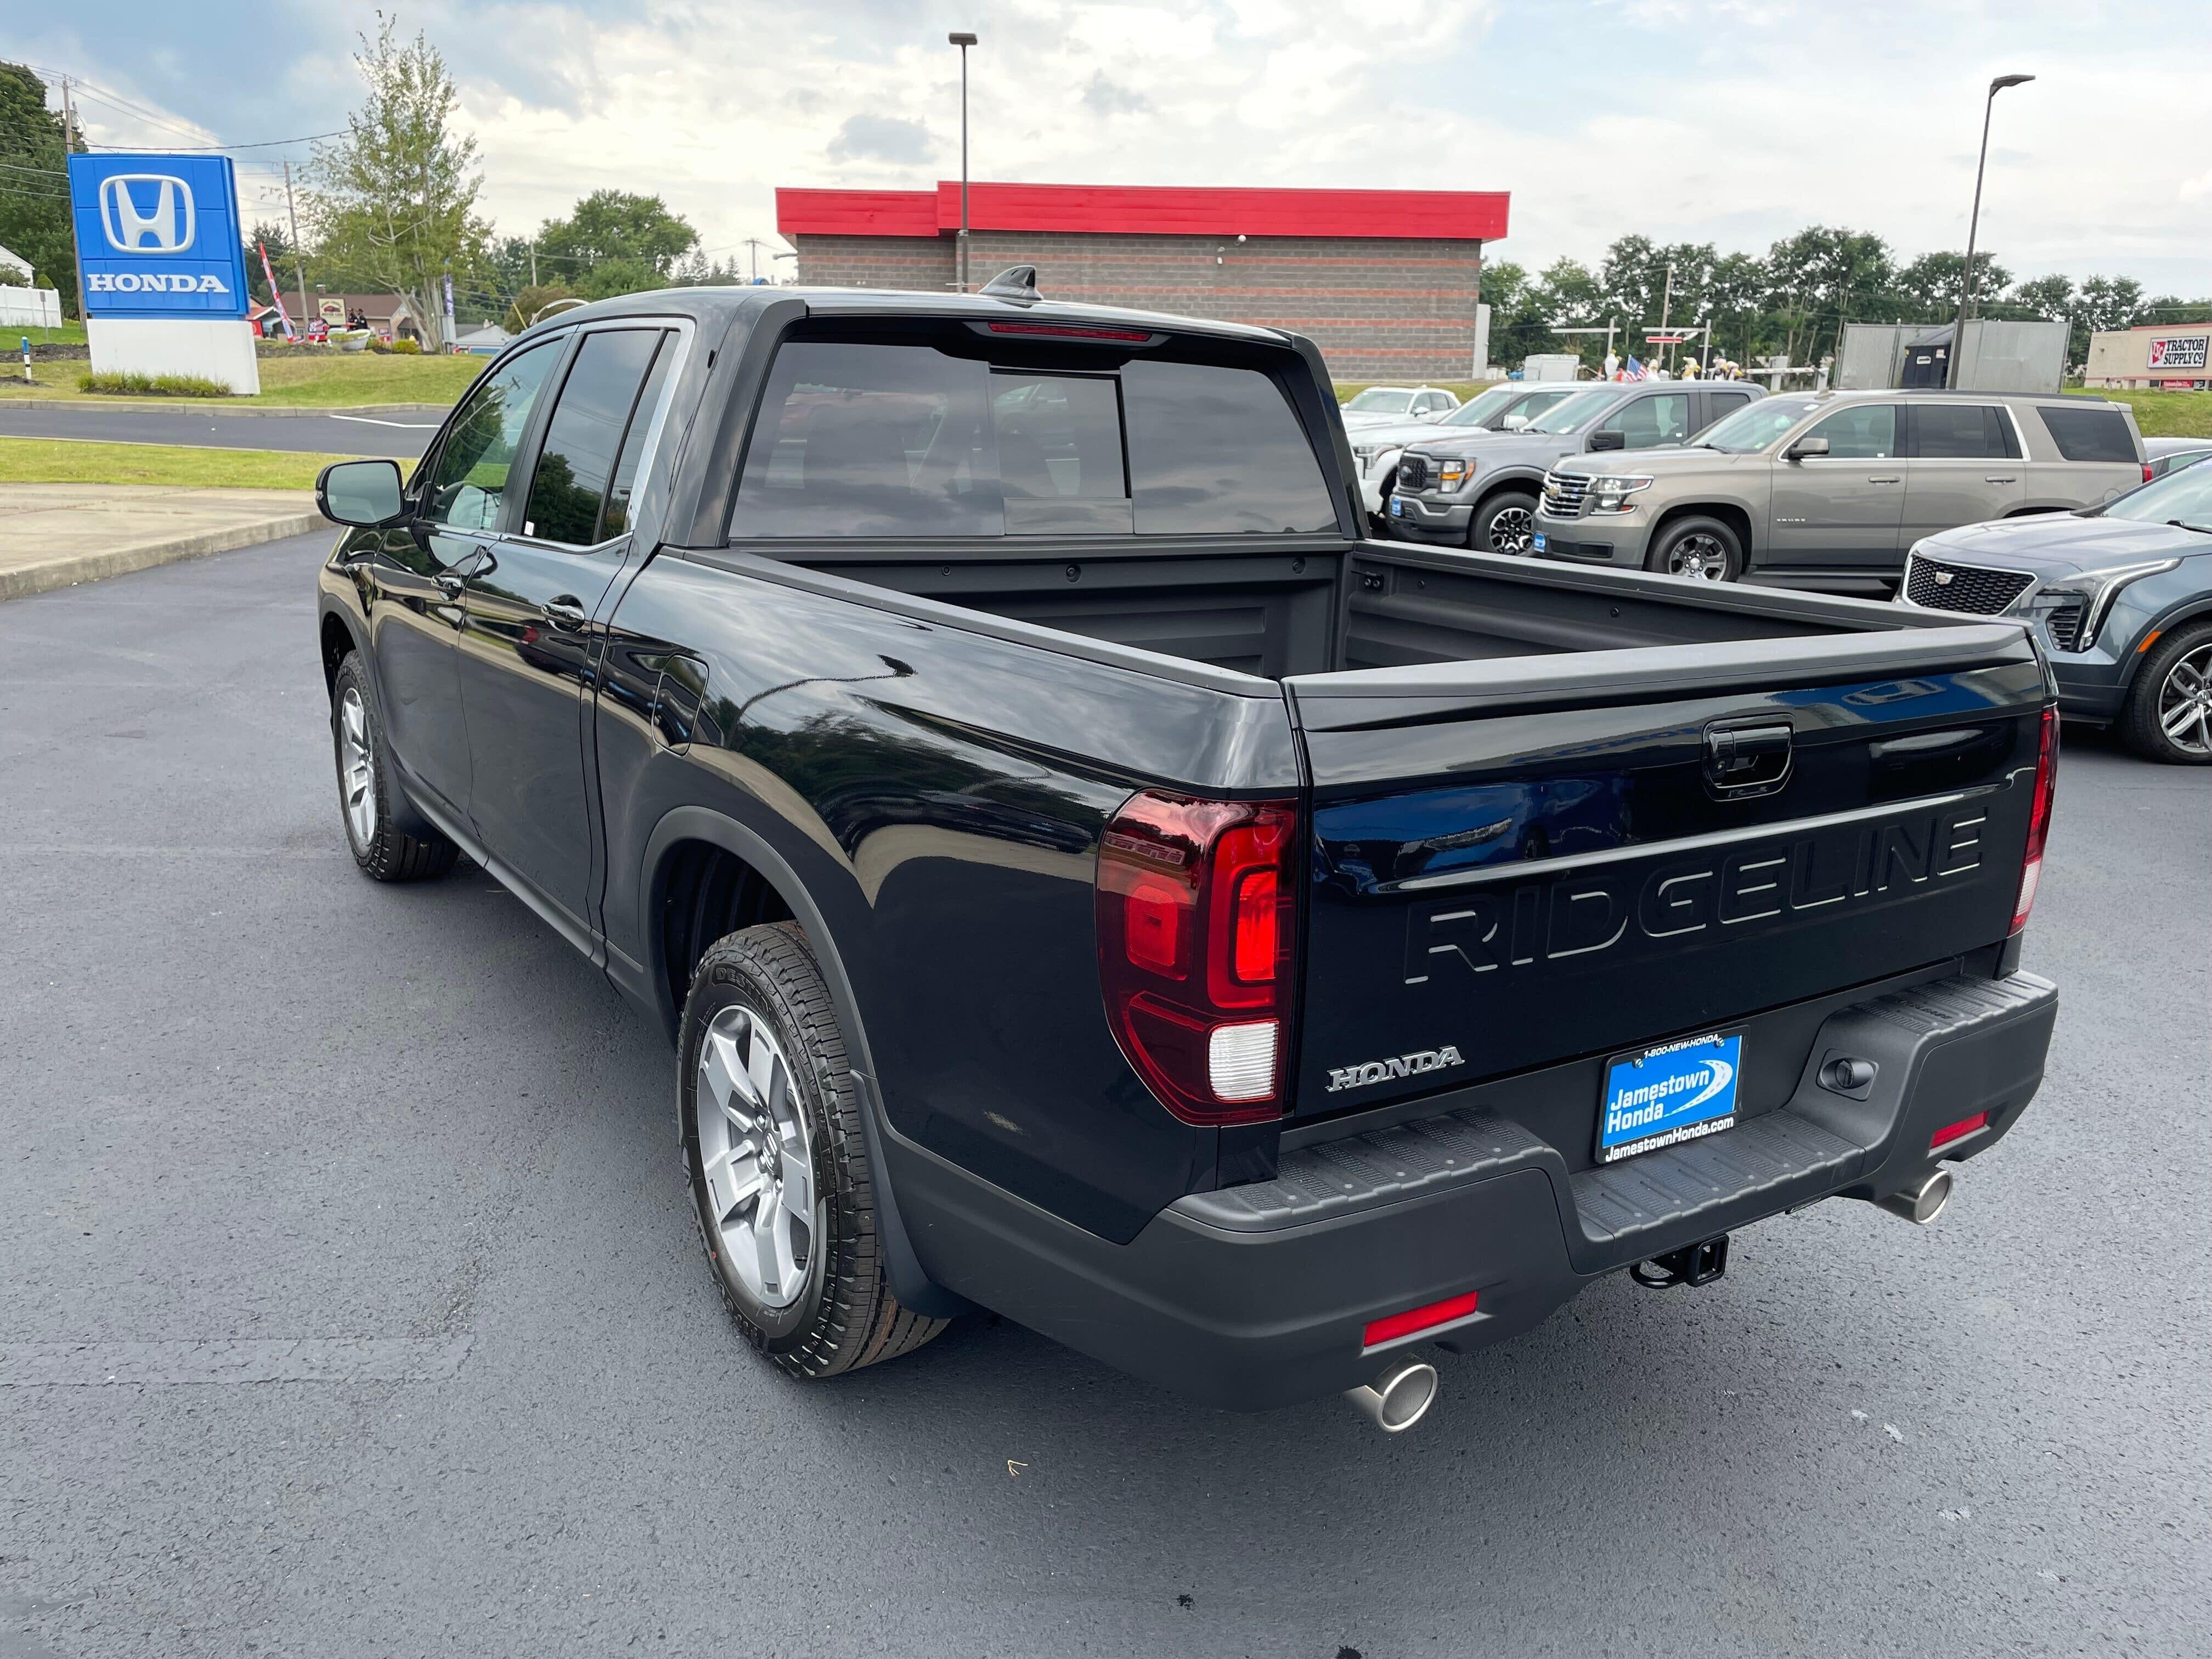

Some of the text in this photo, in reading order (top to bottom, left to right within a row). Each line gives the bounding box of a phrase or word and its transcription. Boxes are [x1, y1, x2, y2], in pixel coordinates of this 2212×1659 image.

[87, 273, 229, 293] HONDA
[2152, 342, 2164, 361] TSC
[2164, 352, 2193, 365] SUPPLY
[2166, 338, 2204, 351] TRACTOR
[1403, 805, 1988, 984] RIDGELINE
[1644, 1034, 1718, 1059] 1-800-NEW-HONDA
[1324, 1045, 1465, 1093] HONDA
[1610, 1069, 1709, 1111] Jamestown
[1607, 1100, 1664, 1134] Honda
[1605, 1116, 1734, 1162] JamestownHonda.com
